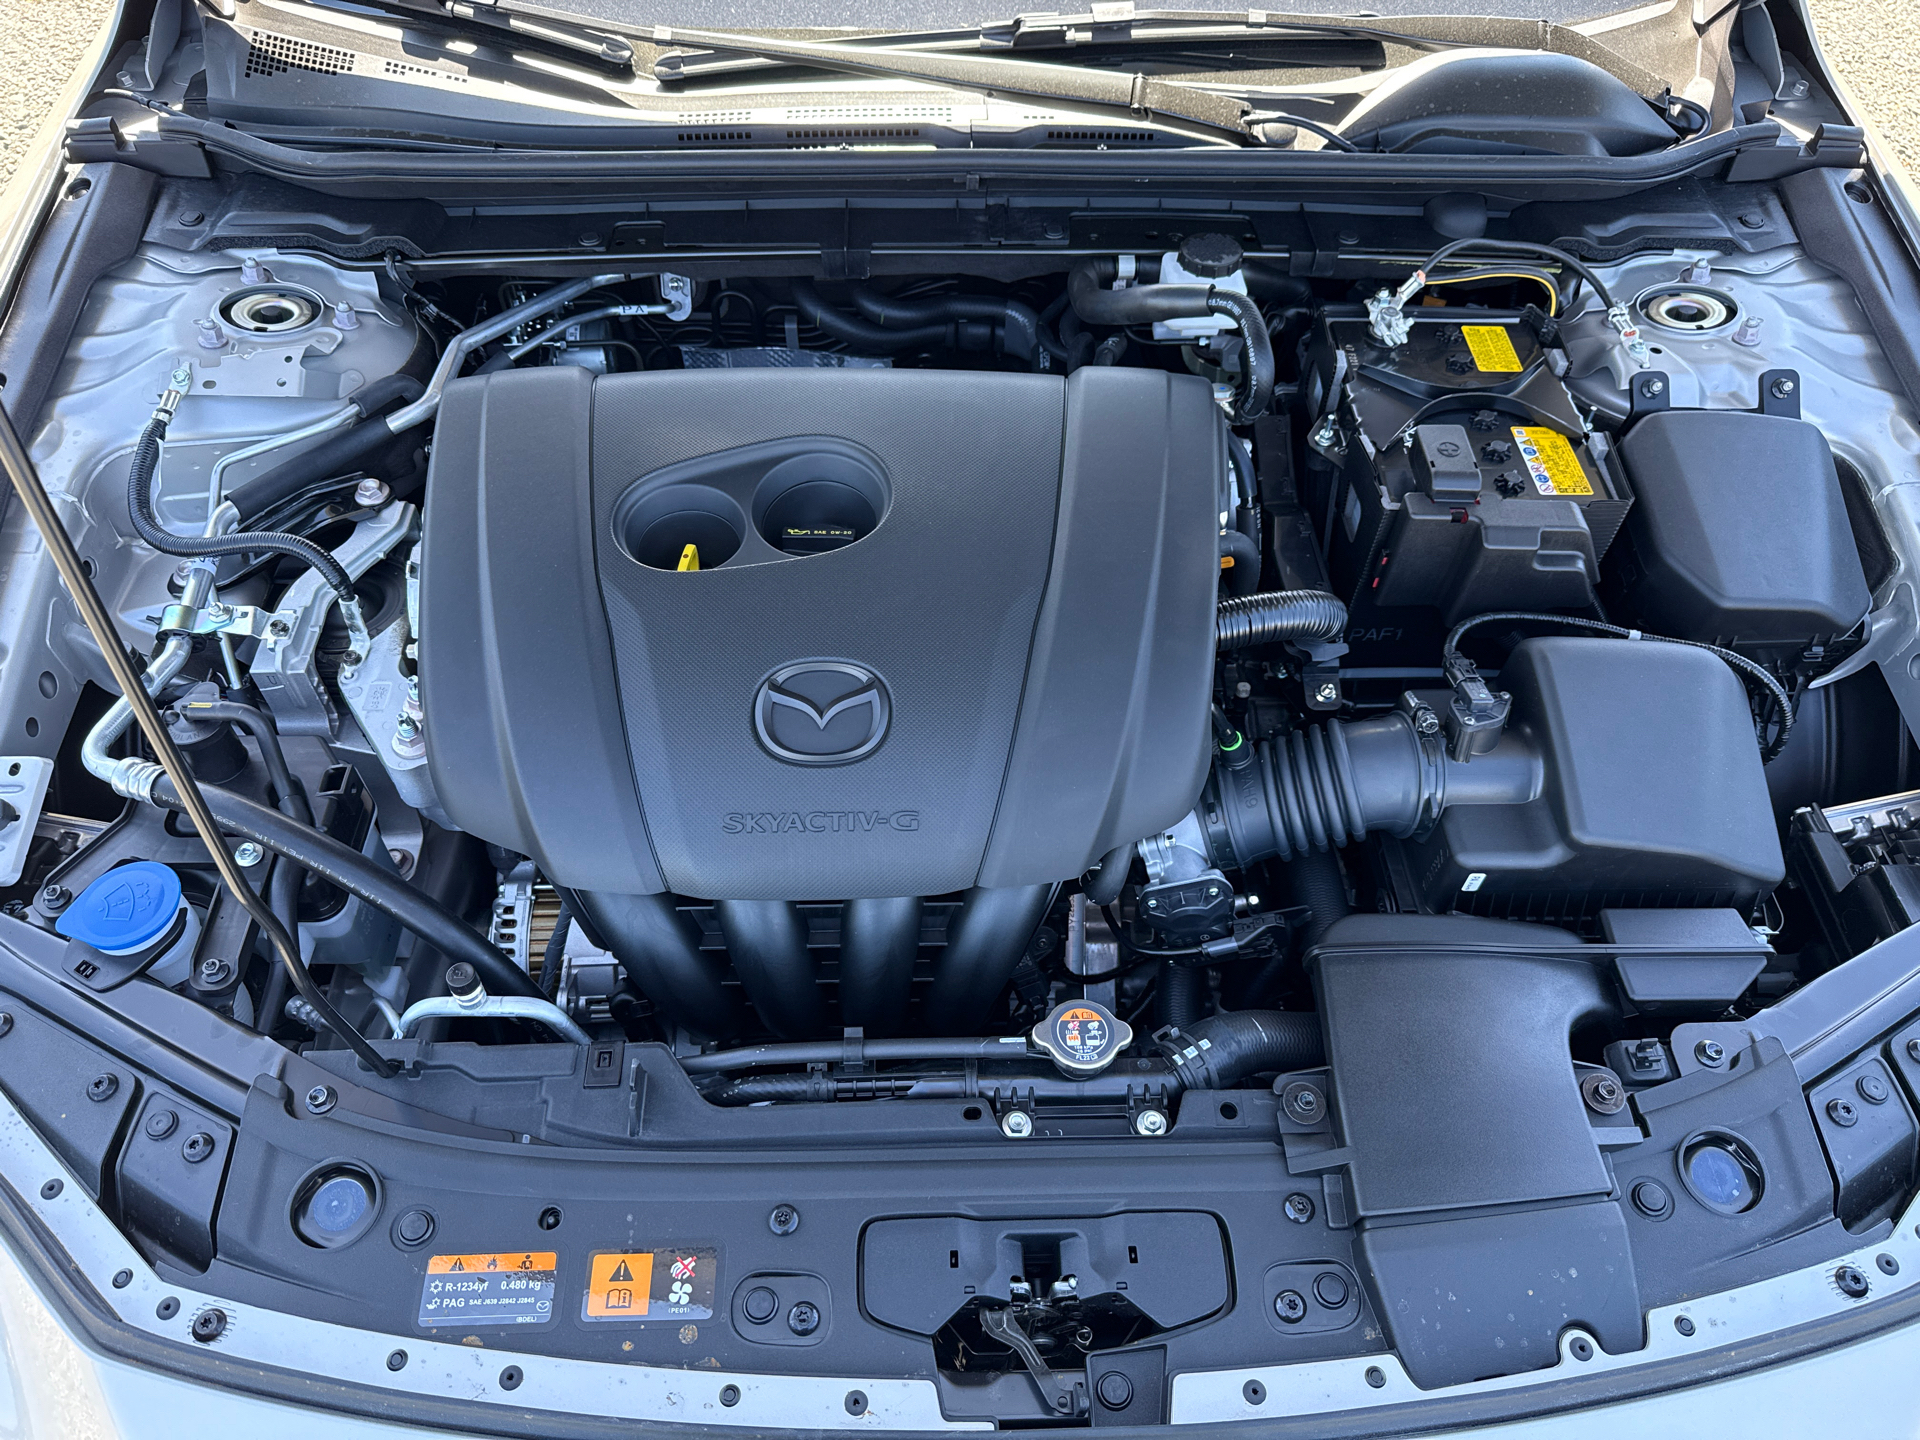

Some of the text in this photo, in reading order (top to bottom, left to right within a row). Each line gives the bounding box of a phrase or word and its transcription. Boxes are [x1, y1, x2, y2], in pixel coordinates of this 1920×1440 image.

[1347, 627, 1403, 642] PAF1
[1239, 769, 1259, 809] PAH9
[722, 810, 920, 834] SKYACTIV-G
[282, 846, 304, 860] PET
[445, 1280, 541, 1293] R-1234yf 0.480 kg
[442, 1297, 465, 1308] PAG
